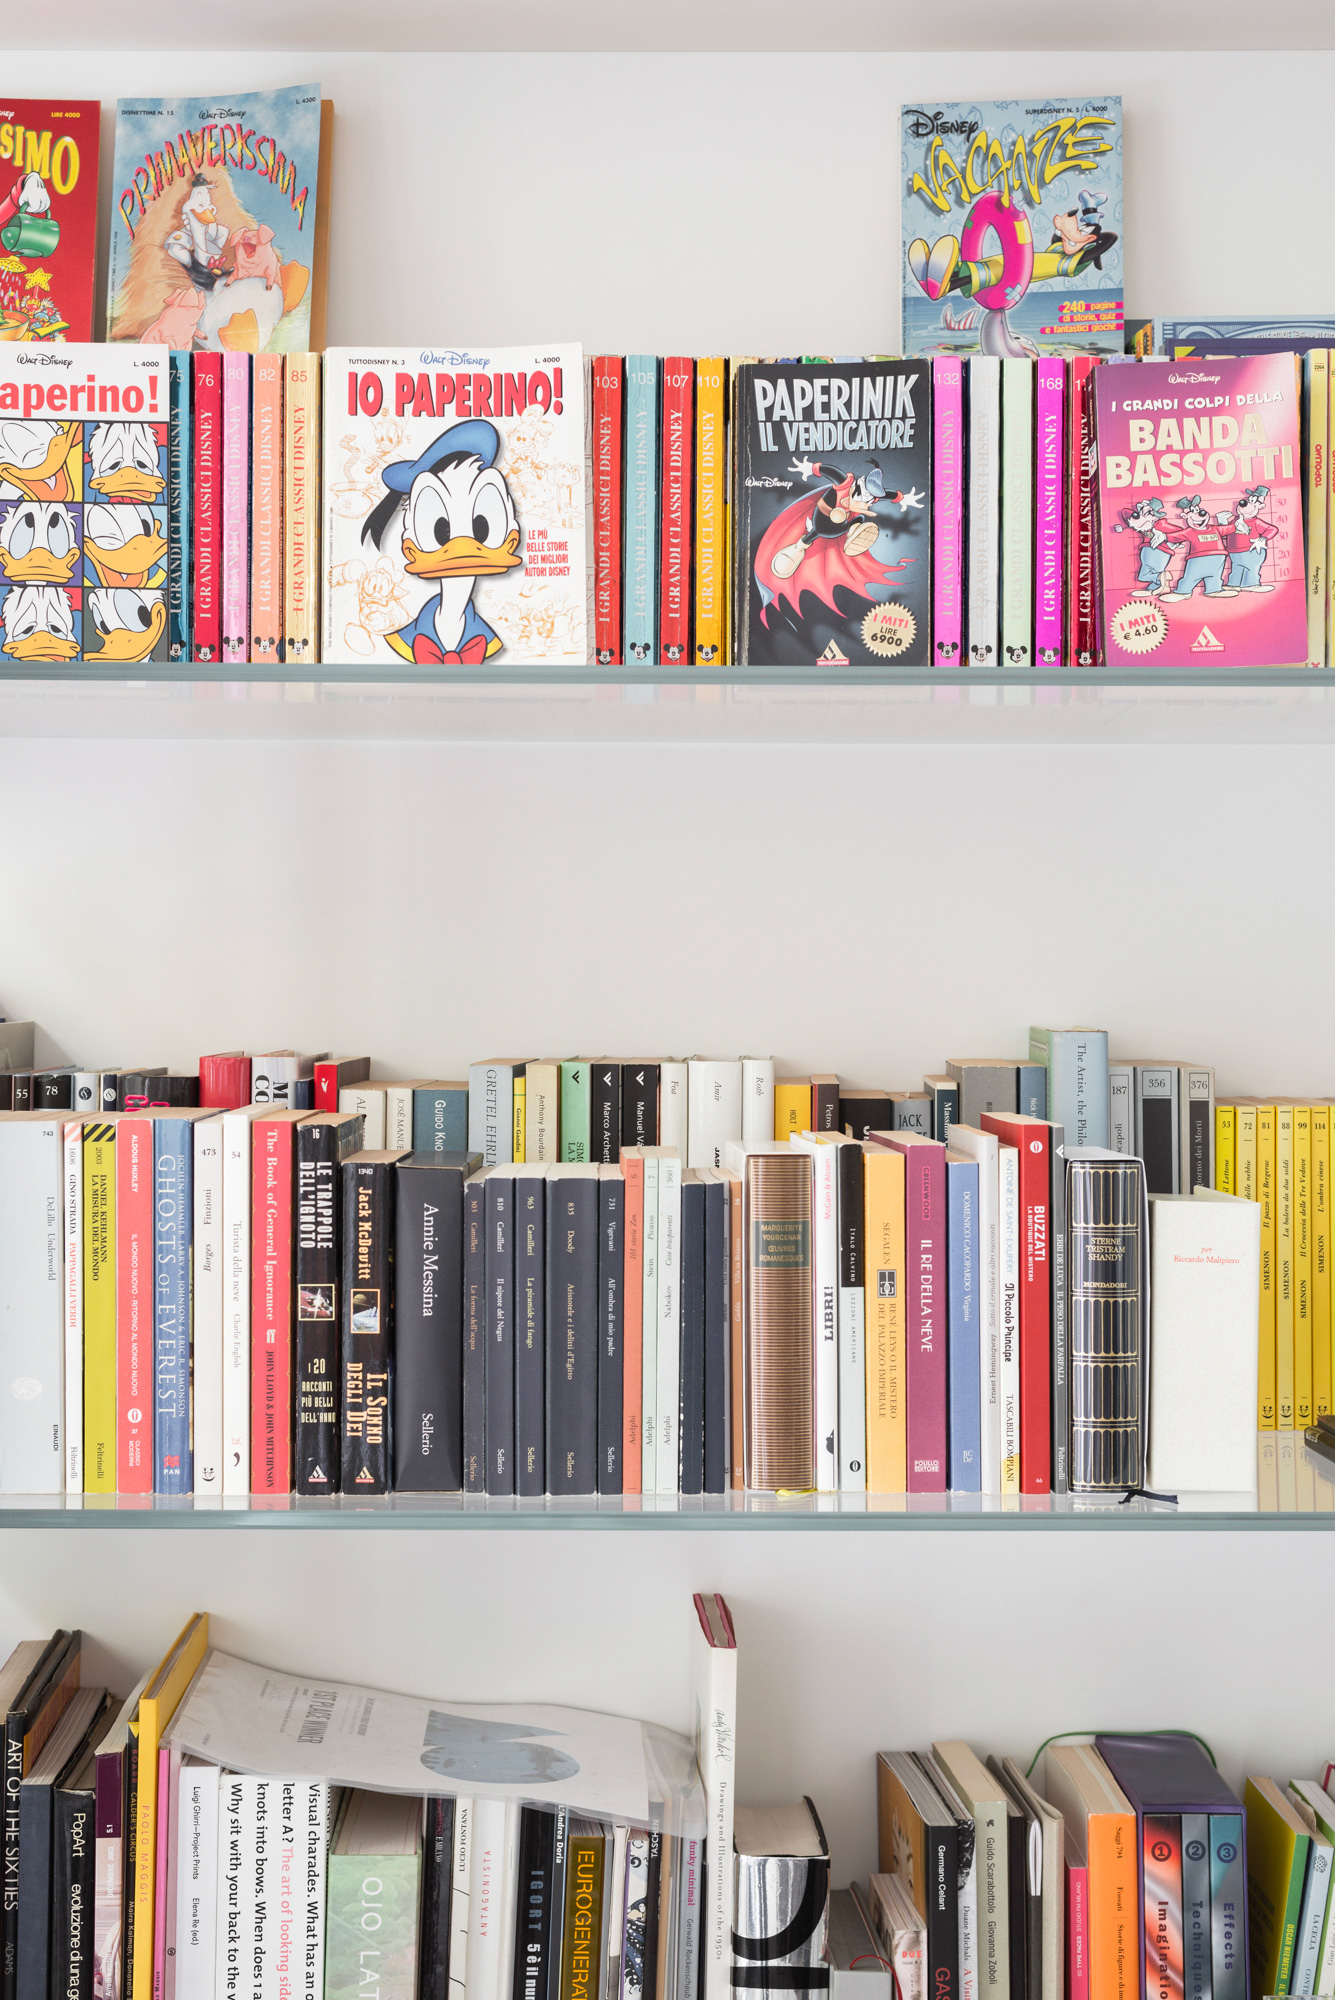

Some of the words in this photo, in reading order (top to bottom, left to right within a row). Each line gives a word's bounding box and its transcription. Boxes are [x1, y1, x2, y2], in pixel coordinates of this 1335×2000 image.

[913, 117, 1115, 212] VACANZE
[118, 123, 308, 241] PRIMAVERISSIMA
[1062, 301, 1085, 313] 240
[1090, 301, 1116, 311] pagine
[198, 374, 214, 387] 76
[259, 369, 275, 381] 82
[665, 375, 689, 387] 107
[936, 373, 959, 385] 132
[1039, 378, 1063, 390] 168
[0, 375, 159, 418] aperino!
[348, 372, 383, 417] IO
[395, 367, 563, 417] PAPERINO!
[753, 374, 920, 422] PAPERINIK
[1122, 398, 1178, 412] GRANDI
[1185, 396, 1229, 409] COLPI
[1237, 391, 1283, 406] DELLA
[201, 409, 212, 468] DISNEY
[670, 409, 683, 469] DISNEY
[759, 422, 779, 452] IL
[783, 418, 916, 451] VENDICATORE
[1129, 413, 1268, 452] BANDA
[1105, 445, 1294, 488] BASSOTTI
[1314, 444, 1322, 488] TOPOLINO
[200, 471, 212, 540] CLASSICI
[668, 472, 682, 543] CLASSICI
[527, 542, 545, 552] BELLE
[547, 541, 568, 551] STORIE
[528, 530, 537, 540] LE
[525, 567, 547, 577] AUTORI
[549, 566, 570, 576] DISNEY
[528, 555, 539, 565] DEI
[541, 554, 568, 564] MIGLIORI
[199, 547, 212, 609] GRANDI
[668, 550, 680, 610] GRANDI
[880, 626, 898, 636] LIRE
[881, 615, 909, 629] MITI
[1134, 624, 1158, 638] 4.60
[870, 633, 902, 647] 6900
[1077, 1043, 1087, 1061] The
[46, 1084, 58, 1096] 78
[756, 1077, 764, 1096] Roth
[1077, 1065, 1087, 1097] Artist,
[1148, 1079, 1166, 1088] 356
[1190, 1080, 1207, 1090] 376
[486, 1069, 497, 1128] GRETEL
[1078, 1100, 1087, 1116] the
[312, 1129, 320, 1139] 16
[898, 1114, 922, 1127] JACK
[1298, 1122, 1307, 1130] 99
[267, 1129, 278, 1152] The
[92, 1175, 99, 1187] LA
[267, 1157, 278, 1188] Book
[317, 1162, 332, 1176] LE
[158, 1155, 176, 1264] GHOSTS
[267, 1193, 277, 1206] of
[300, 1162, 315, 1248] DELL'IGNOTO
[317, 1183, 332, 1249] TRAPPOLE
[358, 1187, 372, 1218] Jack
[963, 1191, 971, 1238] DOMENICO
[267, 1209, 277, 1256] General
[423, 1203, 439, 1251] Annie
[761, 1224, 803, 1232] MARGUERITE
[1034, 1205, 1045, 1261] BUZZATI
[1090, 1237, 1121, 1245] STERNE
[47, 1233, 56, 1281] Underworld
[358, 1222, 372, 1280] McDevitt
[921, 1240, 932, 1250] IL
[1085, 1245, 1126, 1253] TRISTRAM
[1088, 1253, 1124, 1261] SHANDY
[1174, 1255, 1204, 1264] Riccardo
[1206, 1256, 1240, 1265] Malipiero
[1317, 1235, 1325, 1273] SIMENON
[921, 1255, 933, 1271] RE
[963, 1240, 972, 1291] CACOPARDO
[158, 1274, 170, 1295] OF
[264, 1261, 277, 1321] Ignorance
[423, 1254, 439, 1317] Messina
[921, 1275, 933, 1316] DELLA
[921, 1319, 933, 1352] NEVE
[158, 1304, 176, 1418] EVEREST
[347, 1362, 362, 1403] DEGLI
[367, 1373, 387, 1389] IL
[347, 1410, 367, 1437] DEI
[366, 1396, 388, 1444] SONNO
[421, 1413, 433, 1455] Sellerio
[7, 1739, 22, 1773] ART
[6, 1779, 22, 1802] OF
[282, 1783, 295, 1822] letter
[5, 1808, 20, 1841] THE
[70, 1812, 86, 1857] PopArt
[142, 1805, 150, 1846] PAOLO
[460, 1809, 468, 1844] FONTANA
[651, 1819, 660, 1859] TASCHEN
[281, 1846, 294, 1873] The
[689, 1840, 698, 1866] funky
[938, 1845, 946, 1882] Germano
[986, 1838, 995, 1861] Guido
[4, 1847, 20, 1911] SIXTIES
[140, 1852, 149, 1903] MAGGIS
[281, 1876, 293, 1897] art
[480, 1850, 492, 1937] ANTAGONISTA
[687, 1869, 696, 1907] minimal
[986, 1862, 996, 1913] Scarabottolo
[280, 1899, 293, 1916] of
[361, 1877, 383, 1931] OJO
[528, 1870, 545, 1931] IGORT
[938, 1884, 946, 1911] Celant
[70, 1884, 83, 1948] evoluzione
[276, 1918, 292, 1972] looking
[987, 1921, 996, 1958] Giovanna
[1223, 1902, 1235, 1970] Effects
[1285, 1924, 1294, 1946] OSCAR
[70, 1949, 83, 1961] di
[1280, 1946, 1291, 1979] NIEMEYER
[70, 1961, 83, 1988] una
[988, 1960, 997, 1985] Zoboli
